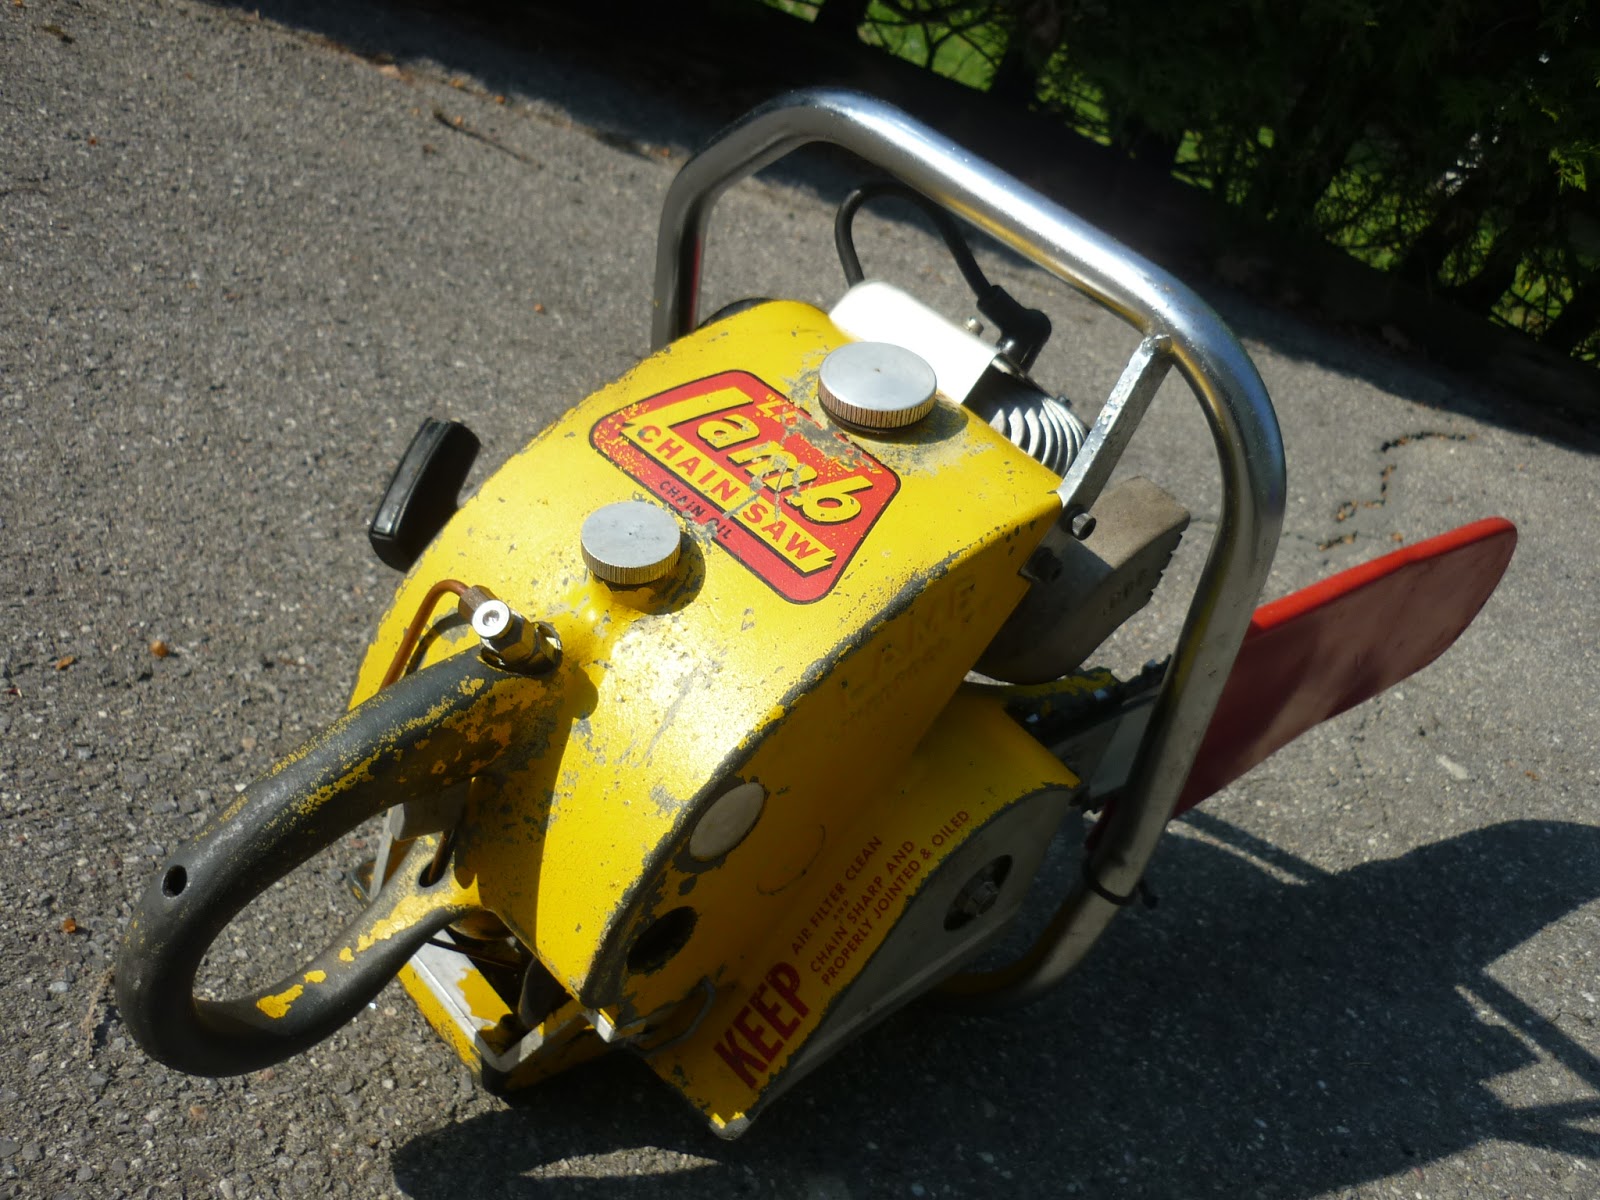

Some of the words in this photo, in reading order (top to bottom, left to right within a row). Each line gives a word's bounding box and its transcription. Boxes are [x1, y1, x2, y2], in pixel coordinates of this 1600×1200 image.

[622, 386, 874, 528] Lamb
[637, 424, 739, 503] CHAIN
[742, 502, 822, 560] SAW
[659, 480, 707, 517] CHAIN
[709, 515, 734, 541] OIL
[791, 928, 813, 956] AIR
[810, 881, 847, 929] FILTER
[845, 835, 883, 882] CLEAN
[809, 926, 848, 974] CHAIN
[846, 875, 884, 926] SHARP
[885, 840, 915, 876] AND
[820, 919, 874, 987] PROPERLY
[873, 860, 922, 921] JOINTED
[920, 848, 932, 860] &
[931, 809, 970, 848] OILED
[832, 899, 850, 921] AND
[713, 961, 811, 1089] KEEP
